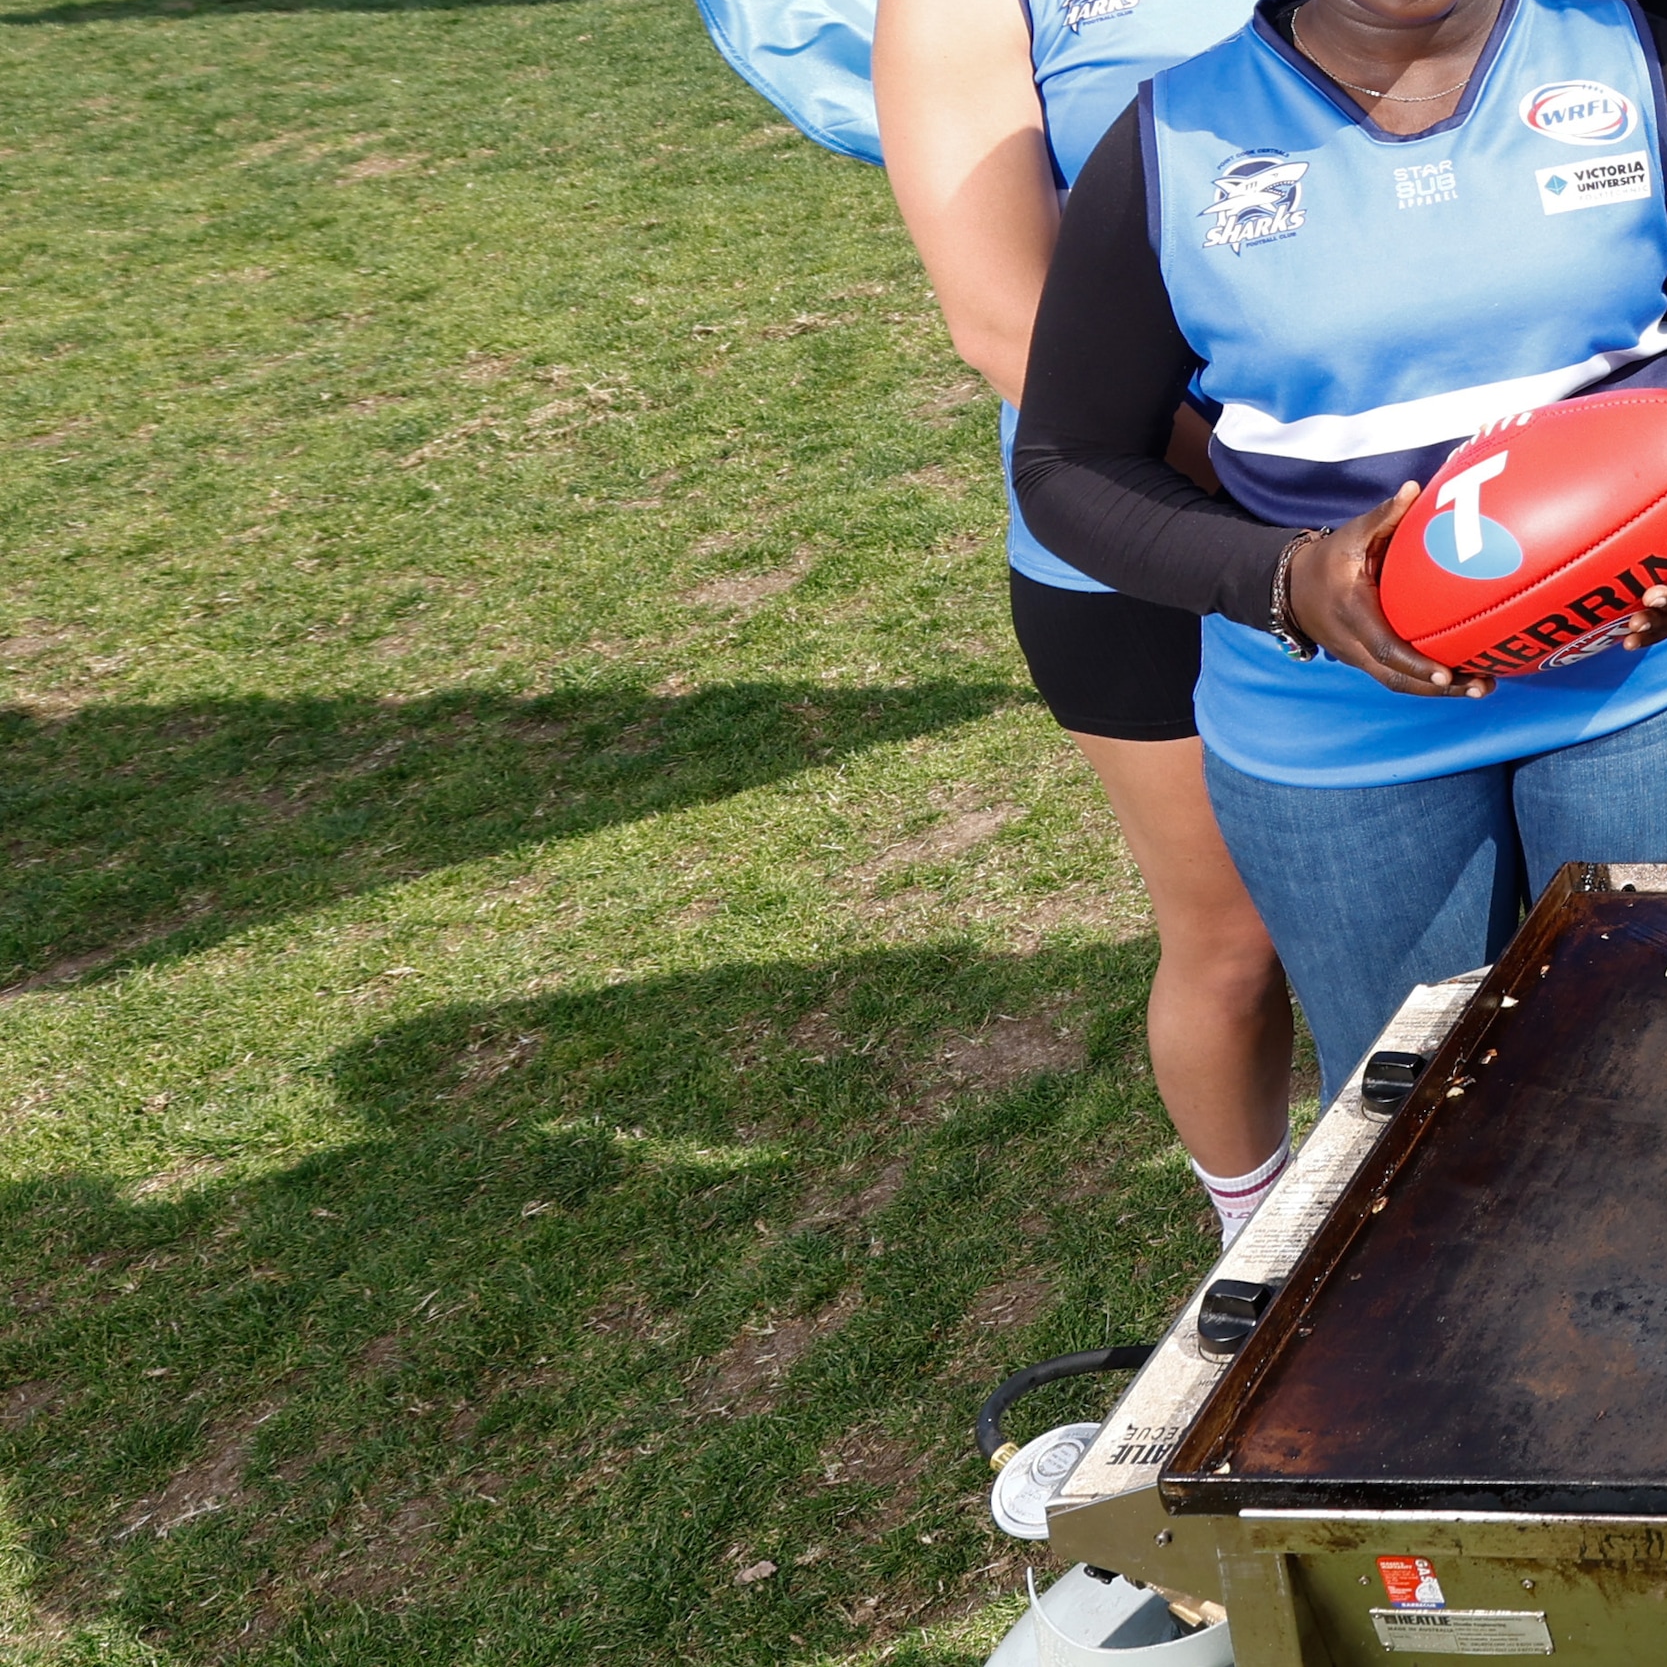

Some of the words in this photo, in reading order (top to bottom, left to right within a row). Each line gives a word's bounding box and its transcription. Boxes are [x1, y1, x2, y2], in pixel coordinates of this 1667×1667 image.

[1541, 99, 1615, 126] WRFL
[1393, 160, 1453, 181] STAR
[1574, 160, 1645, 181] VICTORIA
[1395, 173, 1457, 199] SUB
[1577, 174, 1645, 193] UNIVERSITY
[1398, 190, 1458, 210] APPAREL
[1435, 449, 1509, 564] T
[1106, 1443, 1175, 1466] ATLIE
[1399, 1615, 1452, 1627] HEATLIE
